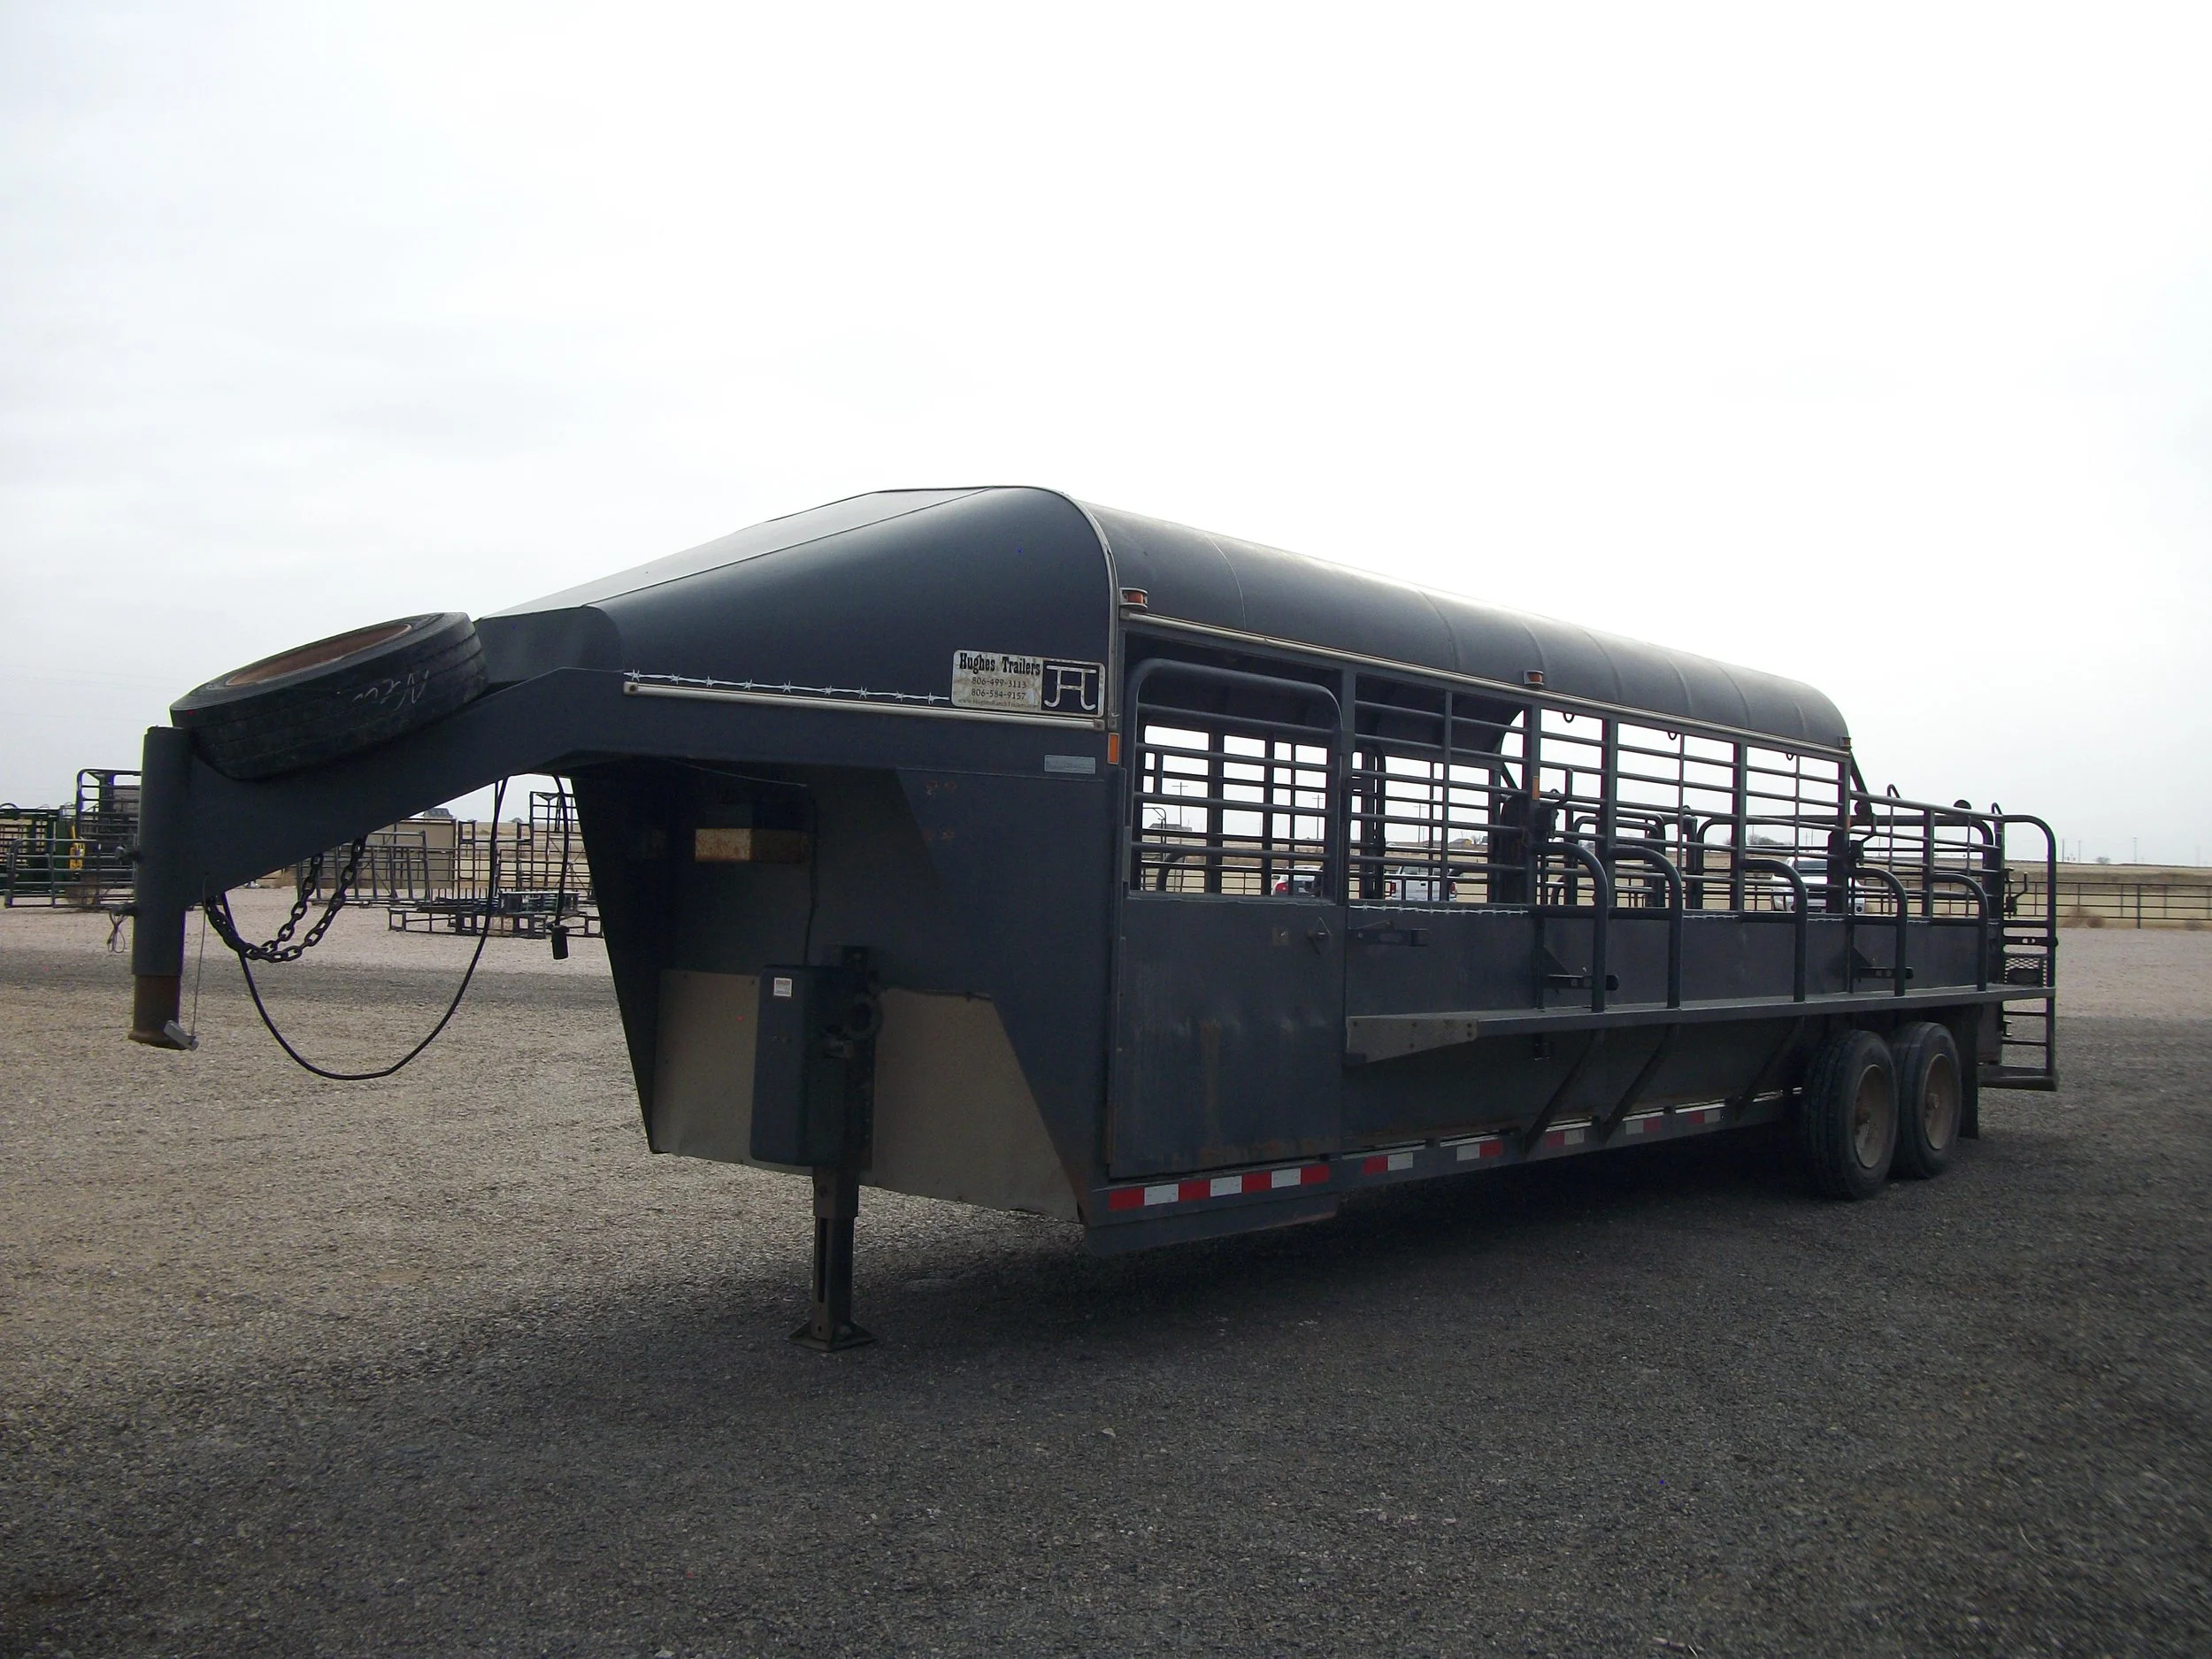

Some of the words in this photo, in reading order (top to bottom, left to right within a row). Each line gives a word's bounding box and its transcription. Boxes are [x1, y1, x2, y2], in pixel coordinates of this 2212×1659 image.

[959, 653, 995, 674] Hughes
[1002, 657, 1041, 675] Trailers
[972, 677, 1027, 688] 806-499-3113
[971, 689, 1026, 700] 806-584-9157
